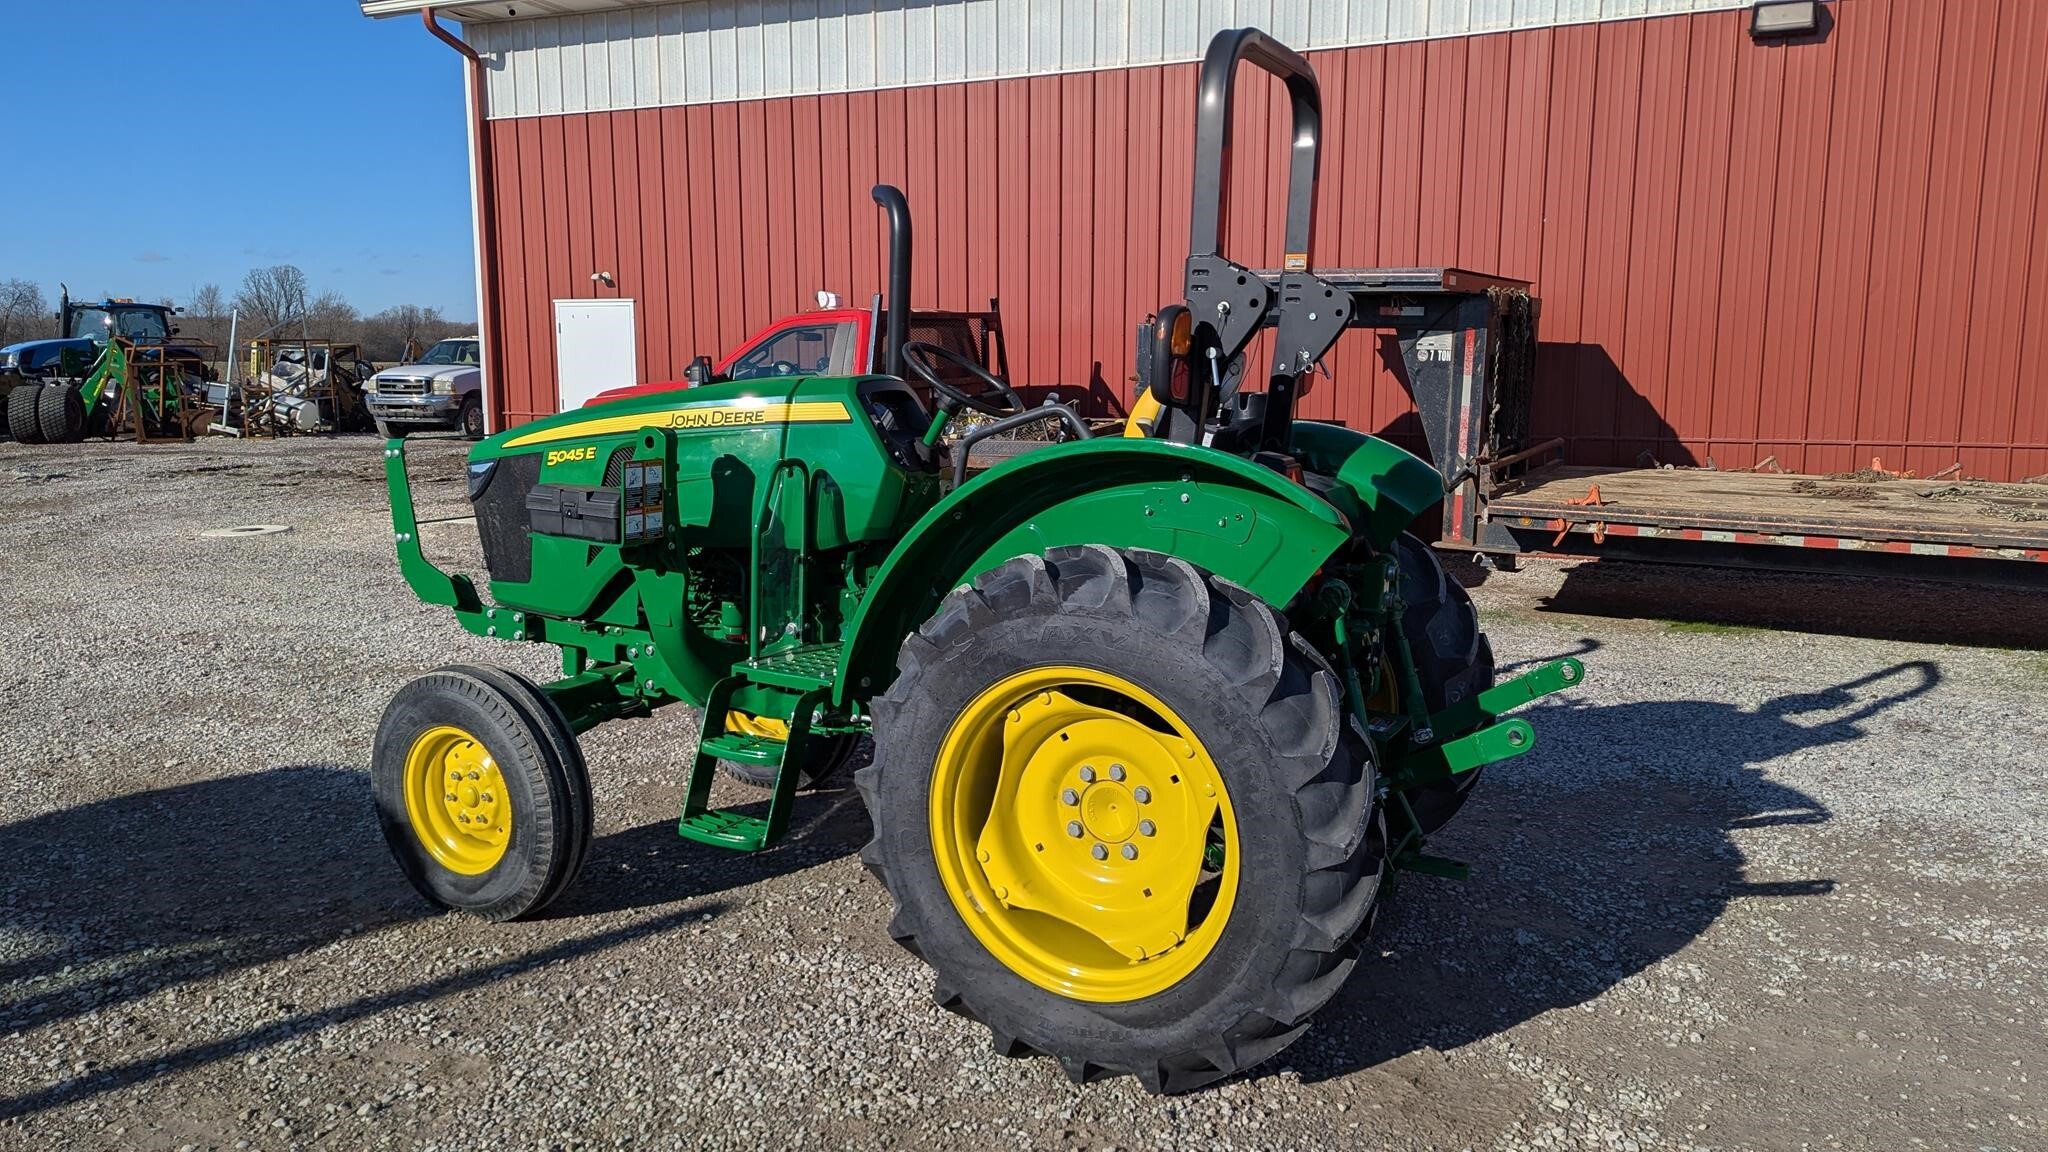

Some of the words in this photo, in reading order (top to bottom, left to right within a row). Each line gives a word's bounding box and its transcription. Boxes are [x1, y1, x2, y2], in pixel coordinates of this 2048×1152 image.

[1429, 349, 1435, 362] 7
[1437, 349, 1452, 362] TON
[665, 413, 708, 427] JOHN
[711, 410, 765, 424] DEERE
[546, 447, 585, 466] 5045
[585, 446, 597, 460] E
